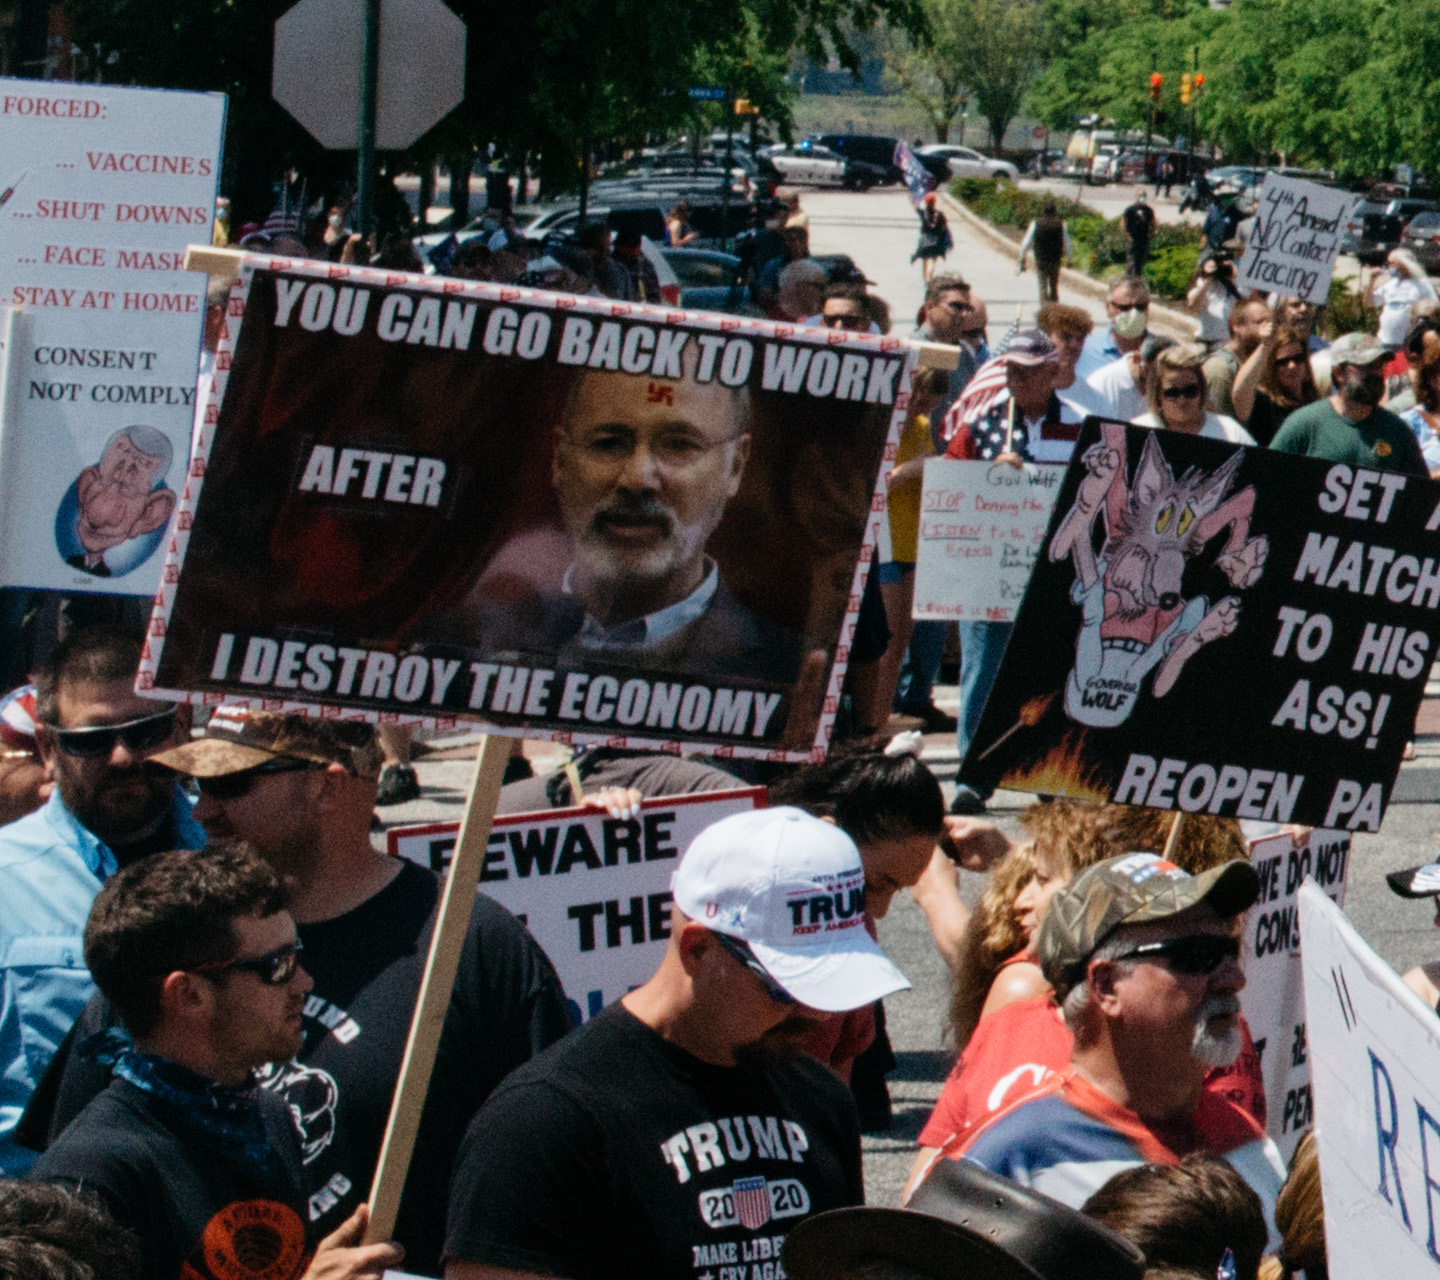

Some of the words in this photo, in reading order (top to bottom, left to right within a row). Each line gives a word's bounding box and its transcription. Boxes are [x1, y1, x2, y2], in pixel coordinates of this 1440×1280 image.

[2, 95, 107, 120] FORCED:
[86, 151, 212, 177] VACCINES
[115, 203, 208, 225] DOWNS
[43, 245, 106, 267] FACE
[1280, 223, 1338, 264] Contact
[1246, 243, 1318, 300] Tracing
[80, 289, 115, 311] AT
[122, 292, 199, 314] HOME
[34, 346, 157, 371] CONSENT
[273, 277, 373, 333] YOU
[375, 293, 475, 353] CAN
[482, 307, 551, 360] GO
[557, 316, 695, 380] BACK
[696, 335, 755, 391] TO
[761, 345, 901, 407] WORK
[28, 380, 82, 403] NOT
[91, 384, 196, 407] COMPLY
[299, 444, 447, 508] AFTER
[1318, 463, 1407, 524] SET
[923, 490, 965, 509] STOP
[1272, 605, 1333, 664] TO
[1352, 622, 1430, 680] HIS
[211, 633, 235, 682] I
[239, 634, 462, 704] DESTROY
[467, 661, 552, 718] THE
[557, 669, 782, 739] ECONOMY
[1081, 687, 1130, 710] WOLF
[1271, 679, 1392, 750] ASS!
[1114, 753, 1305, 823] REOPEN
[1324, 778, 1384, 833] PA
[1257, 855, 1283, 905] WE
[1286, 848, 1312, 896] DO
[1316, 839, 1350, 884] NOT
[793, 924, 823, 937] KEEP
[660, 1115, 810, 1185] TRUMP
[706, 1192, 737, 1222] 20
[772, 1183, 804, 1211] 20
[692, 1241, 738, 1269] MAKE
[742, 1234, 787, 1263] LIBE
